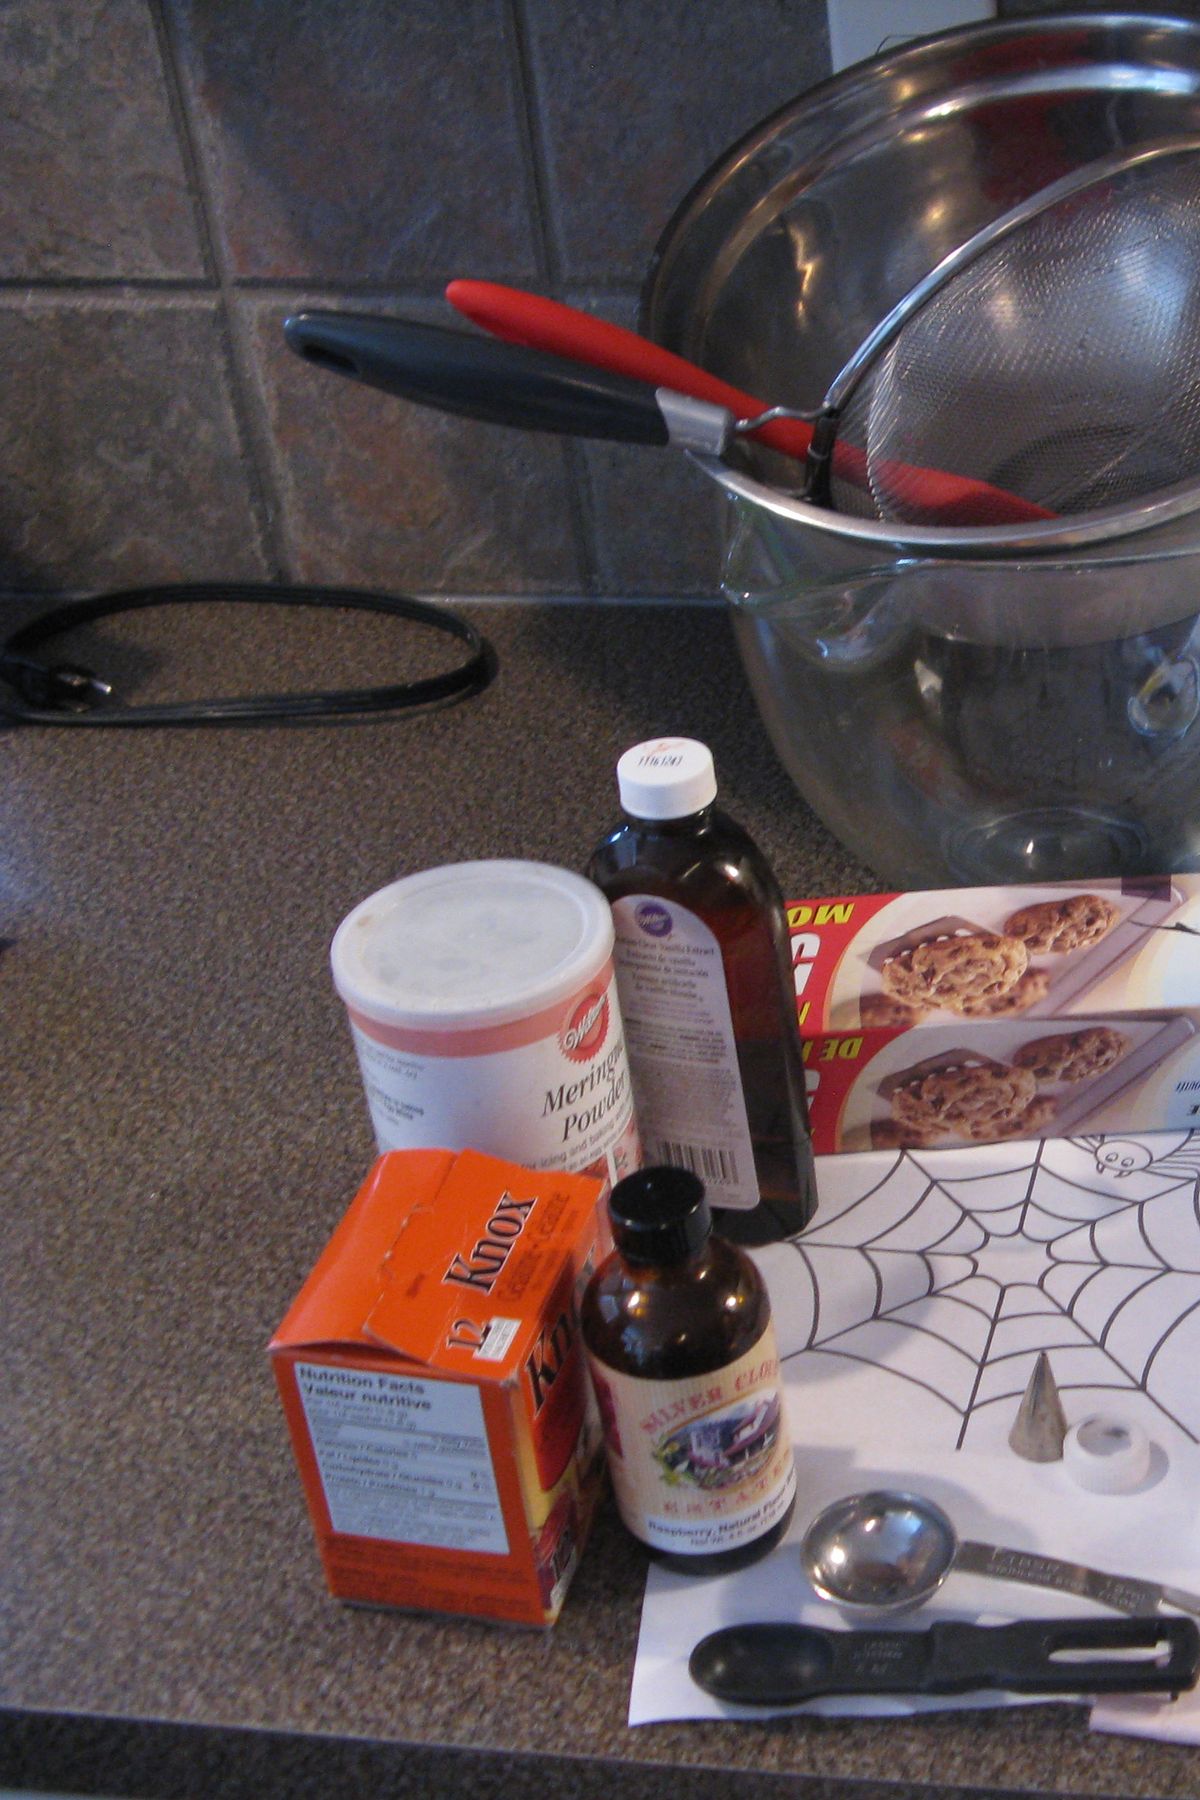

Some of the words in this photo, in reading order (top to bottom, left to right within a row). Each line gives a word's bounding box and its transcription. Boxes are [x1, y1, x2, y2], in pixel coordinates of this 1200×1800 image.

[440, 1189, 539, 1296] Knox
[299, 1365, 374, 1390] Nutrition
[376, 1375, 425, 1396] Facts
[302, 1382, 358, 1401] Valeur
[362, 1390, 432, 1412] nutritive
